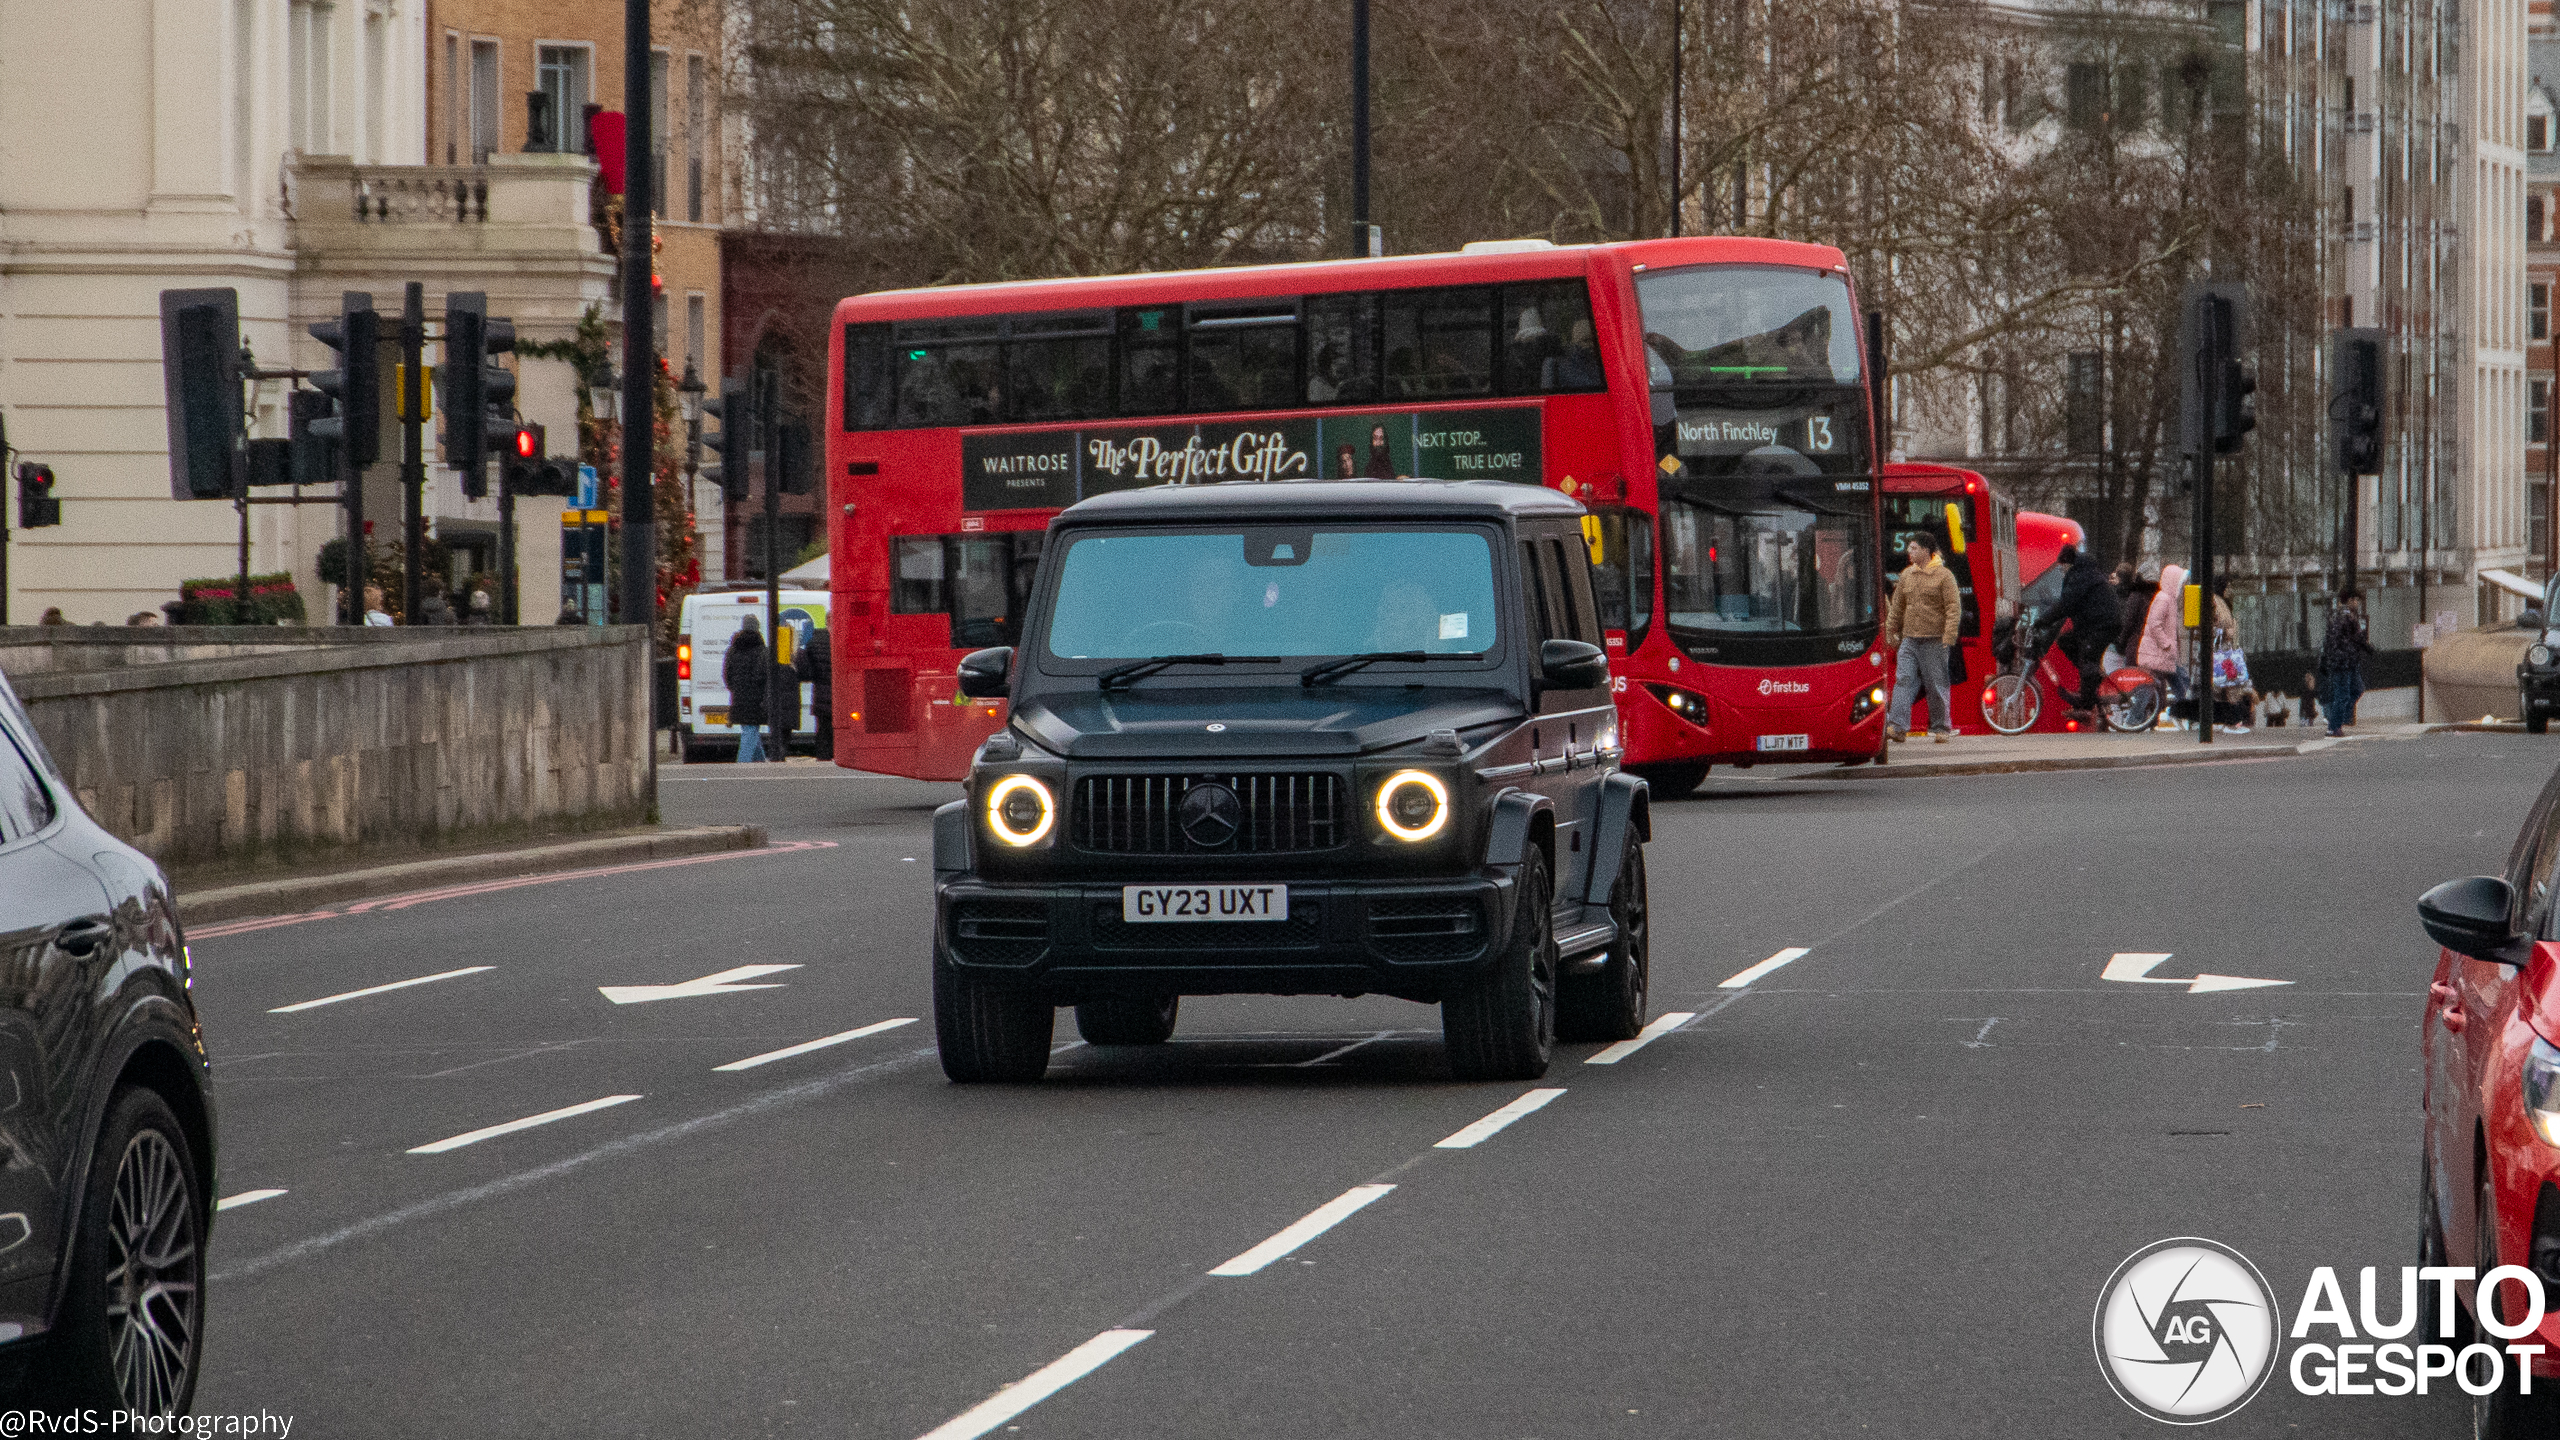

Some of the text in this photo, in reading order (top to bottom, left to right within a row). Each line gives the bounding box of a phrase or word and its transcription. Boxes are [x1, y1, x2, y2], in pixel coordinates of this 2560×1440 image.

[1412, 432, 1447, 448] NEXT
[1678, 421, 1778, 445] North Finchley
[1807, 416, 1833, 450] 13
[983, 453, 1068, 473] WAITROSE
[1089, 432, 1307, 485] The Perfect Gift
[1454, 454, 1484, 470] TRUE
[1006, 478, 1046, 488] PRESENTS
[1773, 681, 1810, 693] first bus
[1137, 889, 1274, 916] GY23 UXT
